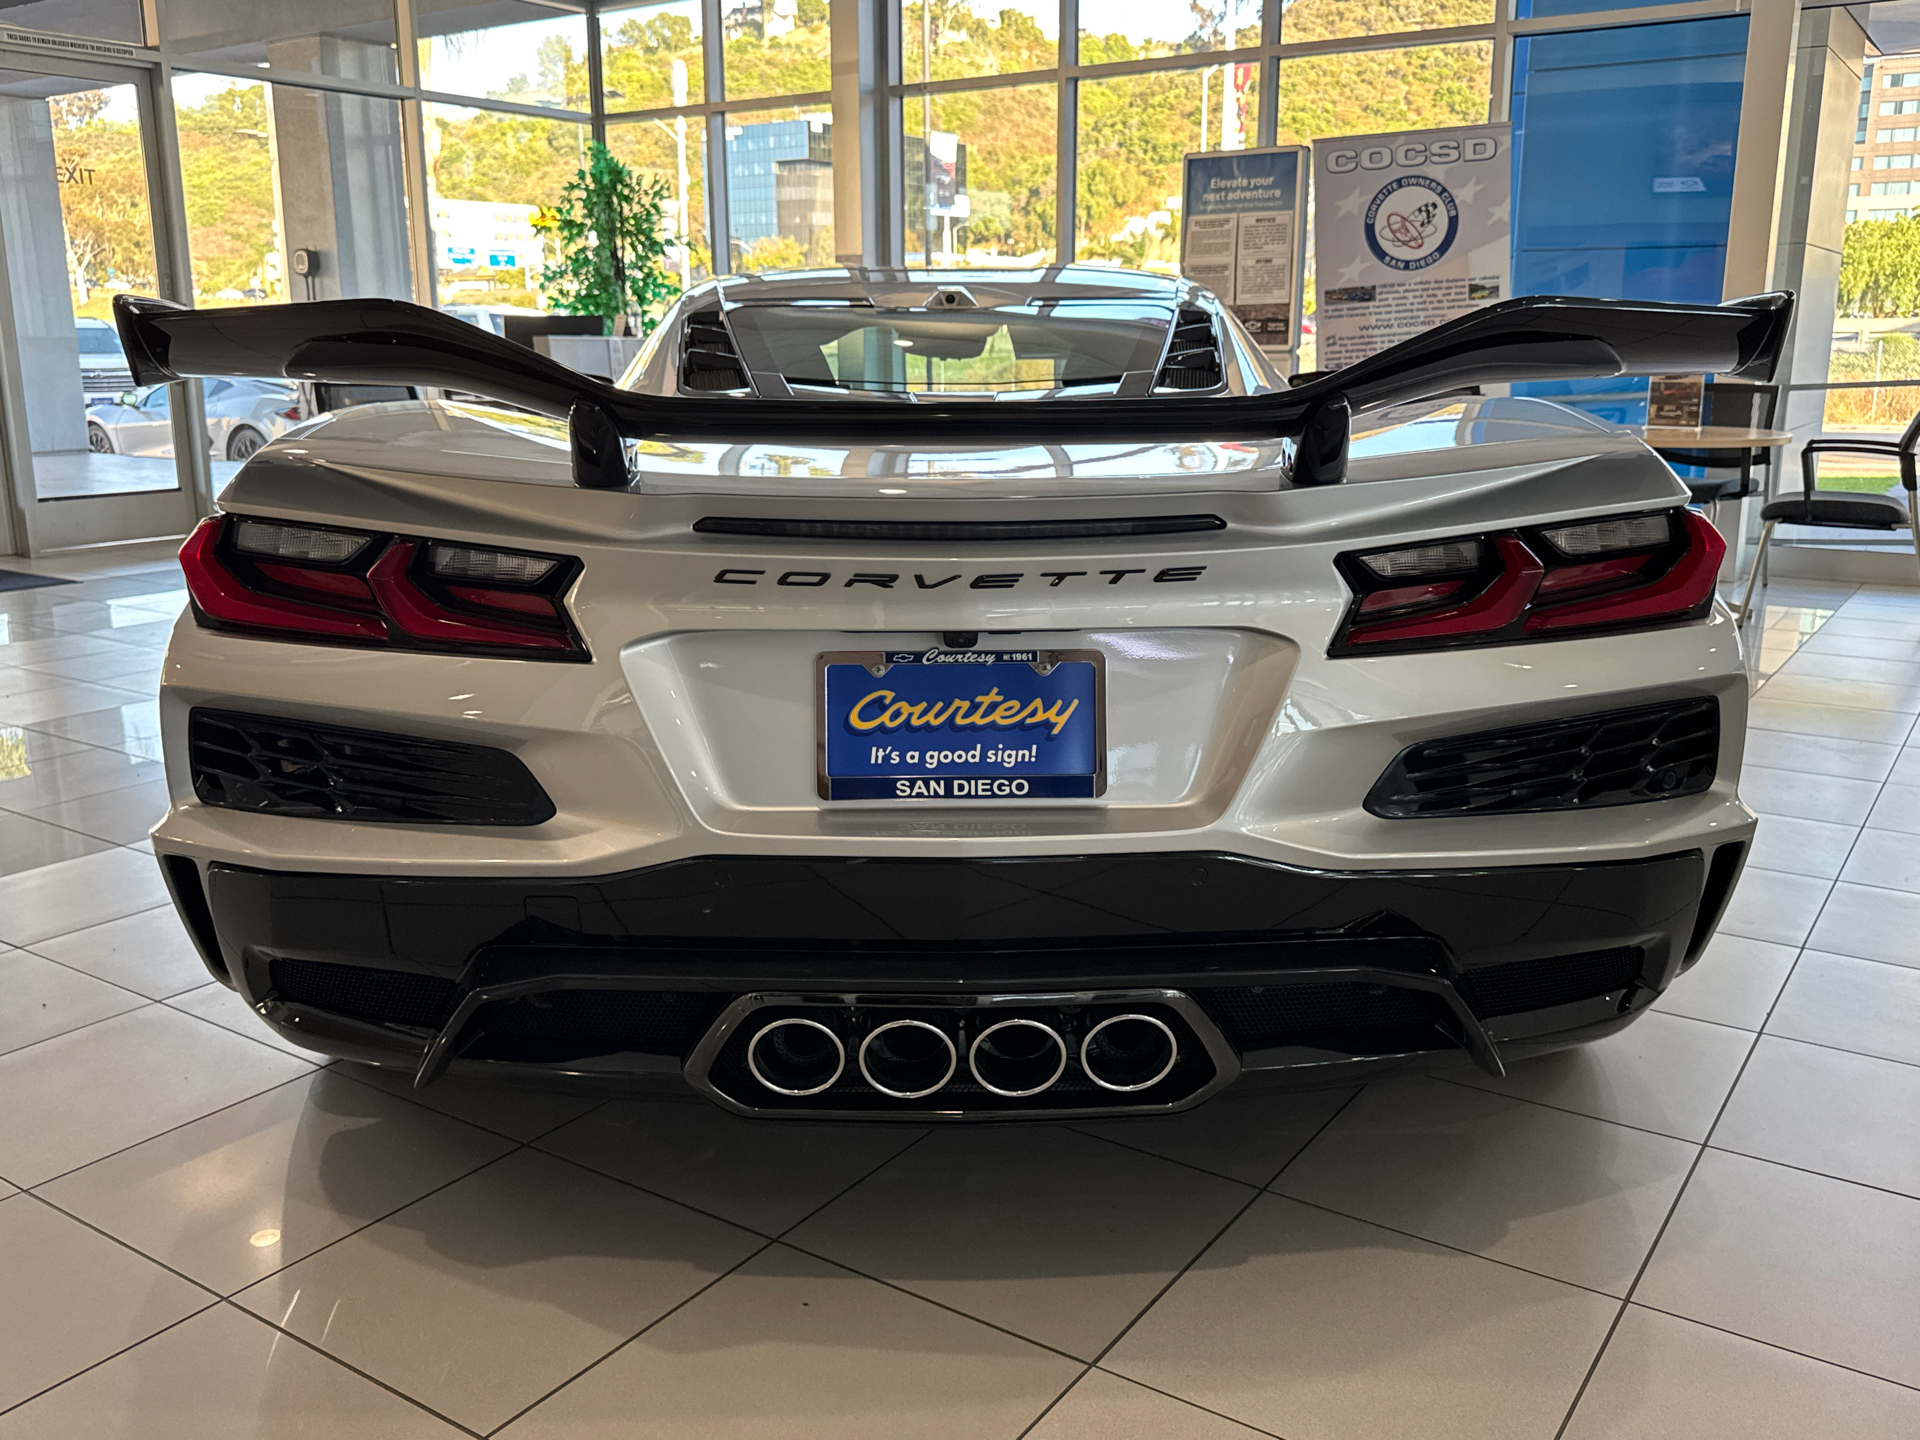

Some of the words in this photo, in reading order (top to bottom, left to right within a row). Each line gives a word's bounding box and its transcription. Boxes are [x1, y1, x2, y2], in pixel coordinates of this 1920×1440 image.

[19, 35, 32, 43] DOORS
[37, 37, 51, 45] REMAIN
[52, 39, 70, 48] UNLOCKED
[96, 45, 112, 53] BUILDING
[117, 47, 134, 56] OCCUPIED
[1326, 137, 1498, 174] COCSD
[51, 165, 96, 186] EXIT
[1210, 177, 1248, 190] Elevate
[1249, 176, 1275, 189] your
[1203, 191, 1226, 202] next
[1227, 189, 1282, 201] adventure
[1366, 181, 1399, 224] CORVETTE
[1401, 177, 1442, 194] OWNERS
[1441, 192, 1457, 217] CLUB
[1382, 254, 1406, 270] SAN
[1408, 251, 1441, 270] DIEGO
[713, 565, 1208, 590] CORVETTE
[922, 648, 997, 667] Courtesy
[1011, 652, 1033, 661] 1961
[848, 686, 1079, 735] Courtesy
[870, 745, 900, 765] It's
[906, 750, 919, 764] a
[925, 744, 981, 769] good
[986, 743, 1037, 768] sign!
[896, 780, 945, 796] SAN
[953, 779, 1029, 796] DIEGO
